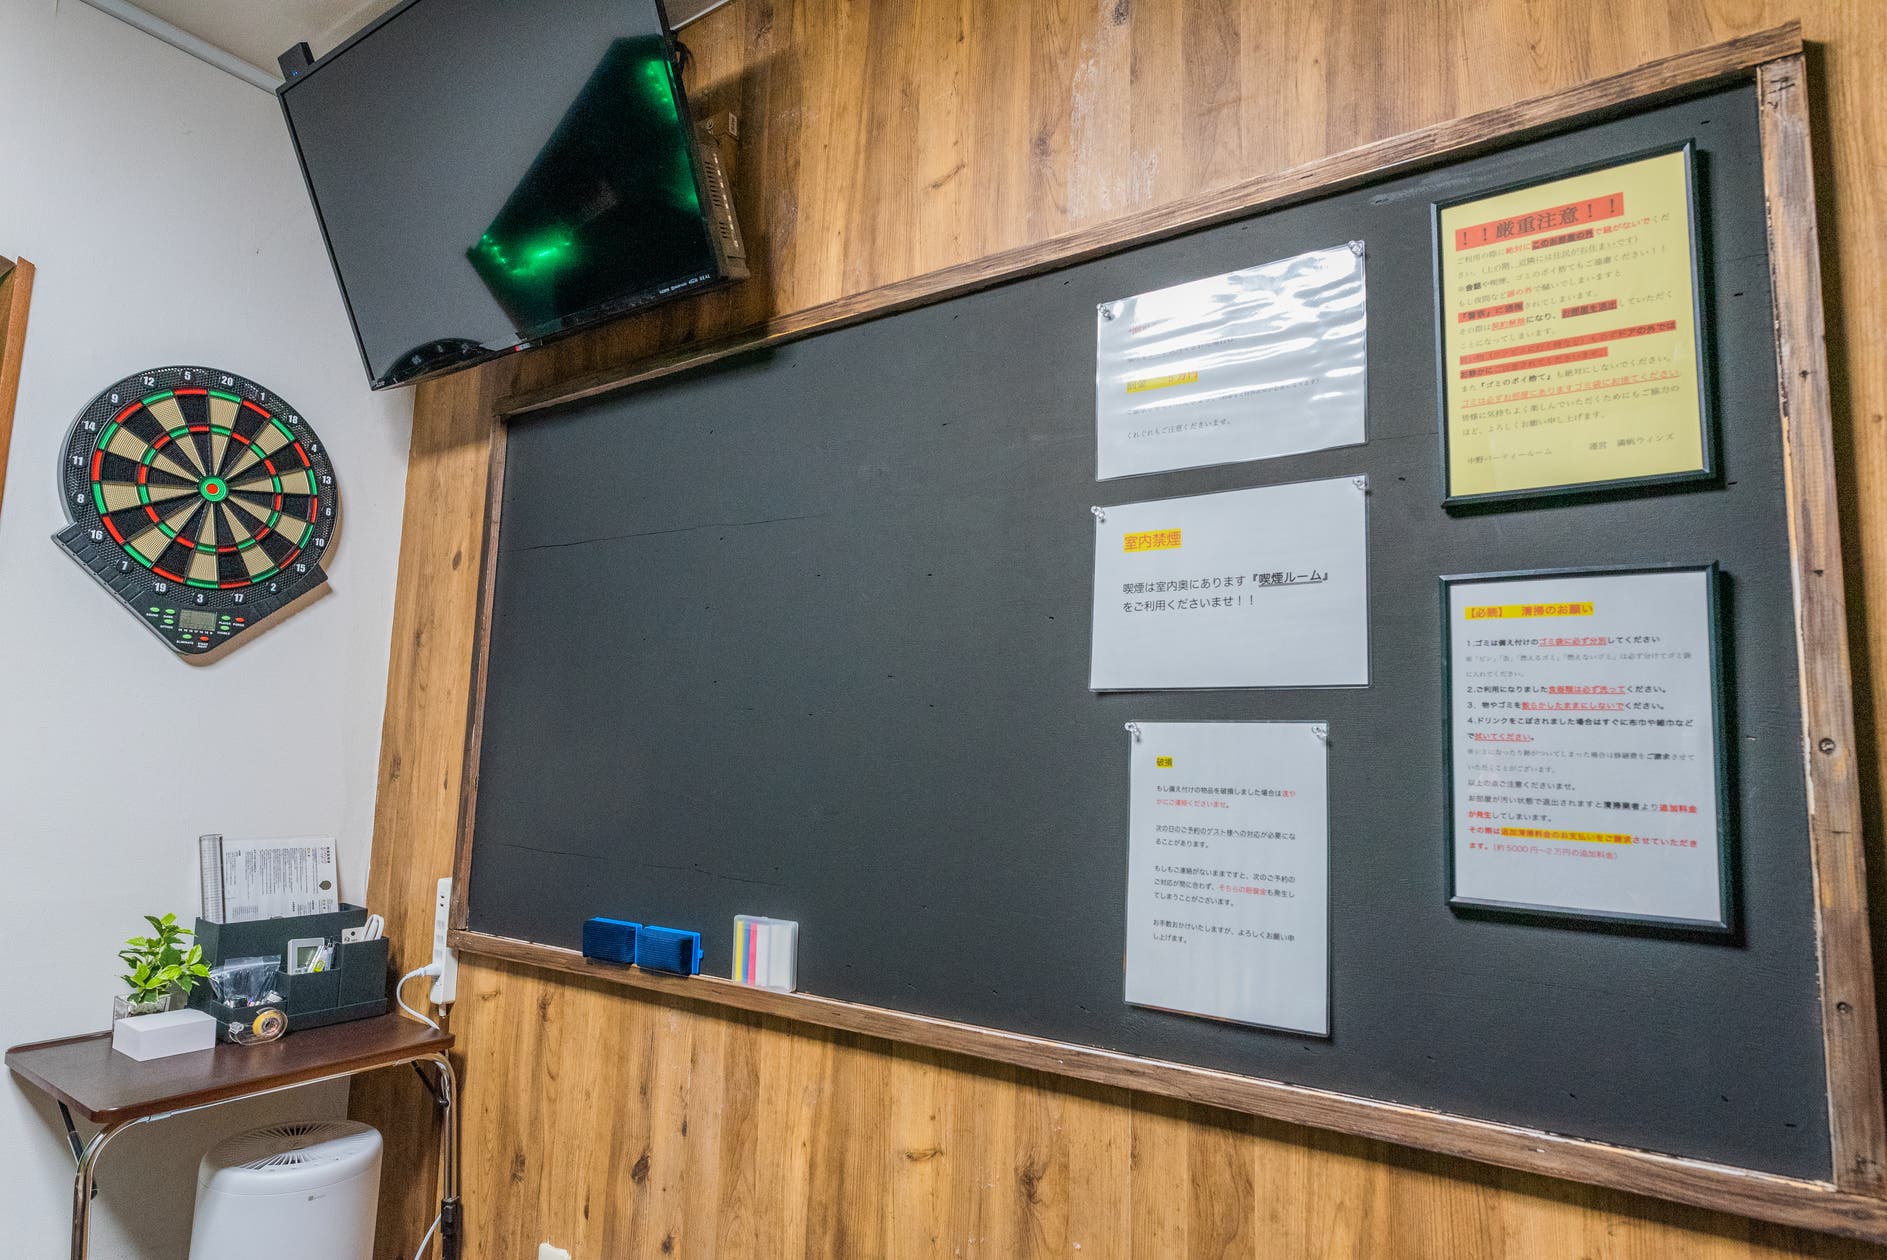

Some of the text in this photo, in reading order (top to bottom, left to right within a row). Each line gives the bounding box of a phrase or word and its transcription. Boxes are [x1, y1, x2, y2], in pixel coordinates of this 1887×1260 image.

[184, 370, 191, 380] 5
[143, 376, 154, 386] 12
[222, 376, 233, 386] 20
[111, 394, 118, 404] 9
[260, 392, 265, 400] 1
[288, 415, 298, 424] 18
[84, 421, 96, 431] 14
[311, 444, 318, 452] 4
[72, 456, 83, 466] 11
[322, 476, 332, 484] 13
[77, 494, 84, 504] 8
[325, 508, 331, 516] 6
[91, 530, 102, 540] 16
[1124, 530, 1181, 550] 室内禁煙
[314, 538, 324, 547] 10
[122, 562, 128, 570] 7
[296, 564, 306, 573] 15
[155, 582, 167, 592] 19
[270, 582, 277, 592] 2
[1123, 569, 1329, 595] 喫煙は室内奥にあります『喫煙ルーム』
[197, 594, 204, 603] 3
[233, 594, 244, 603] 17
[1123, 594, 1255, 613] をご利用くださいませ！！
